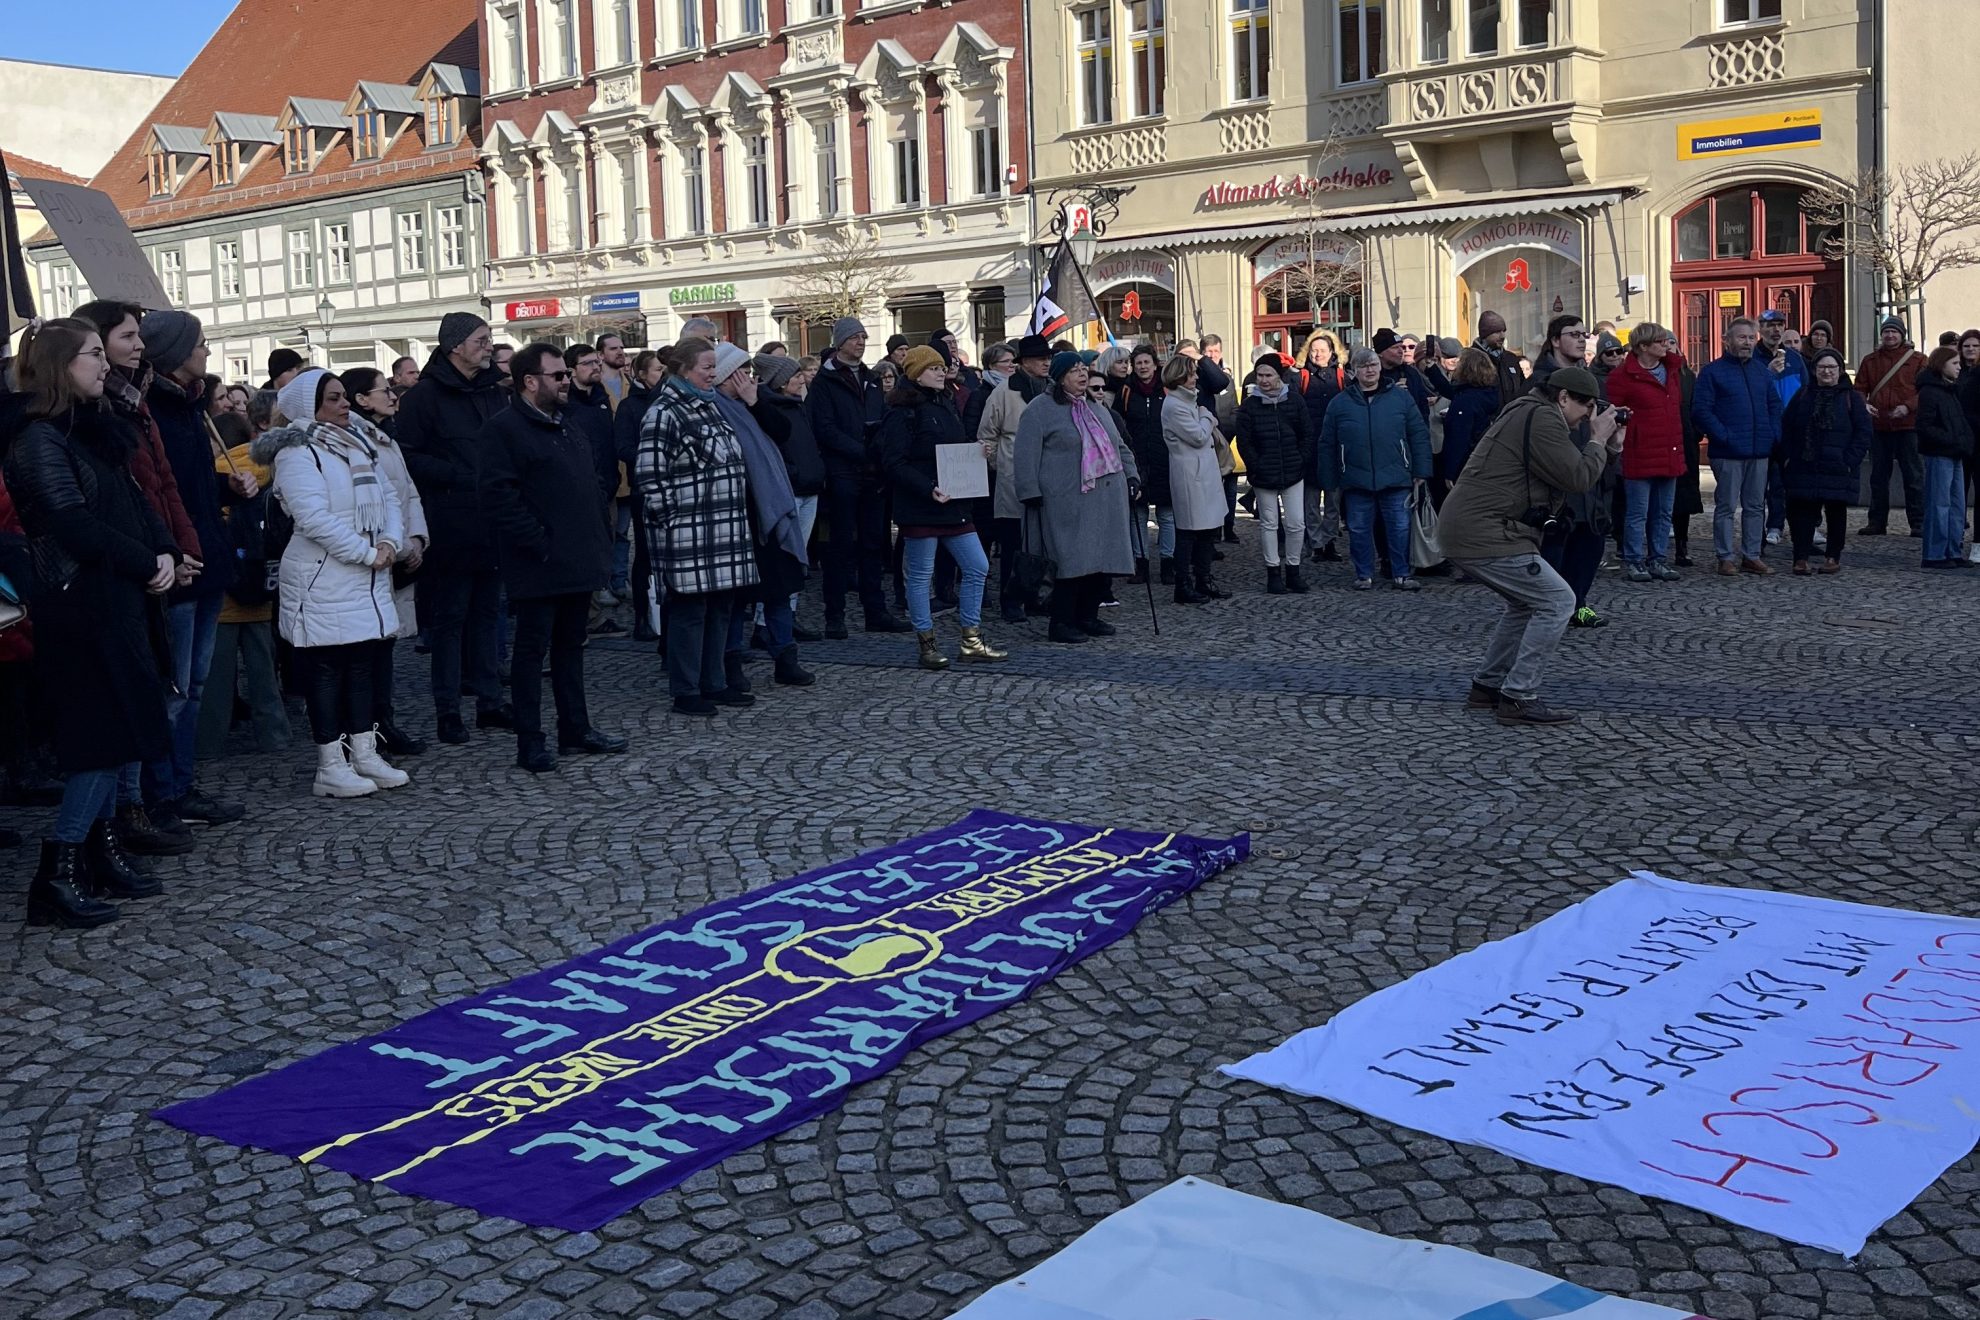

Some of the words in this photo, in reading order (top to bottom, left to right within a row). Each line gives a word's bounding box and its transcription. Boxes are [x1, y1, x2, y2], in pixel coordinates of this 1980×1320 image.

[1696, 137, 1743, 150] Immobilien
[1205, 163, 1394, 206] Altmark-Apotheke
[1461, 221, 1572, 255] HOMÖOPATHIE
[669, 283, 736, 305] BARMER
[1099, 258, 1166, 280] ALLOPATHIE
[515, 302, 547, 318] DERTOUR
[917, 848, 1118, 918] ALTMARK
[367, 823, 1065, 1088] GESELLSCHAFT
[1547, 907, 1757, 998] RECHTER
[1783, 929, 1895, 976] MIT
[624, 995, 767, 1049] OHNE
[1695, 969, 1827, 1031] DEN
[1368, 992, 1585, 1096] GEWALT
[444, 1051, 642, 1122] NAZIS
[1489, 1024, 1743, 1139] OPFERN
